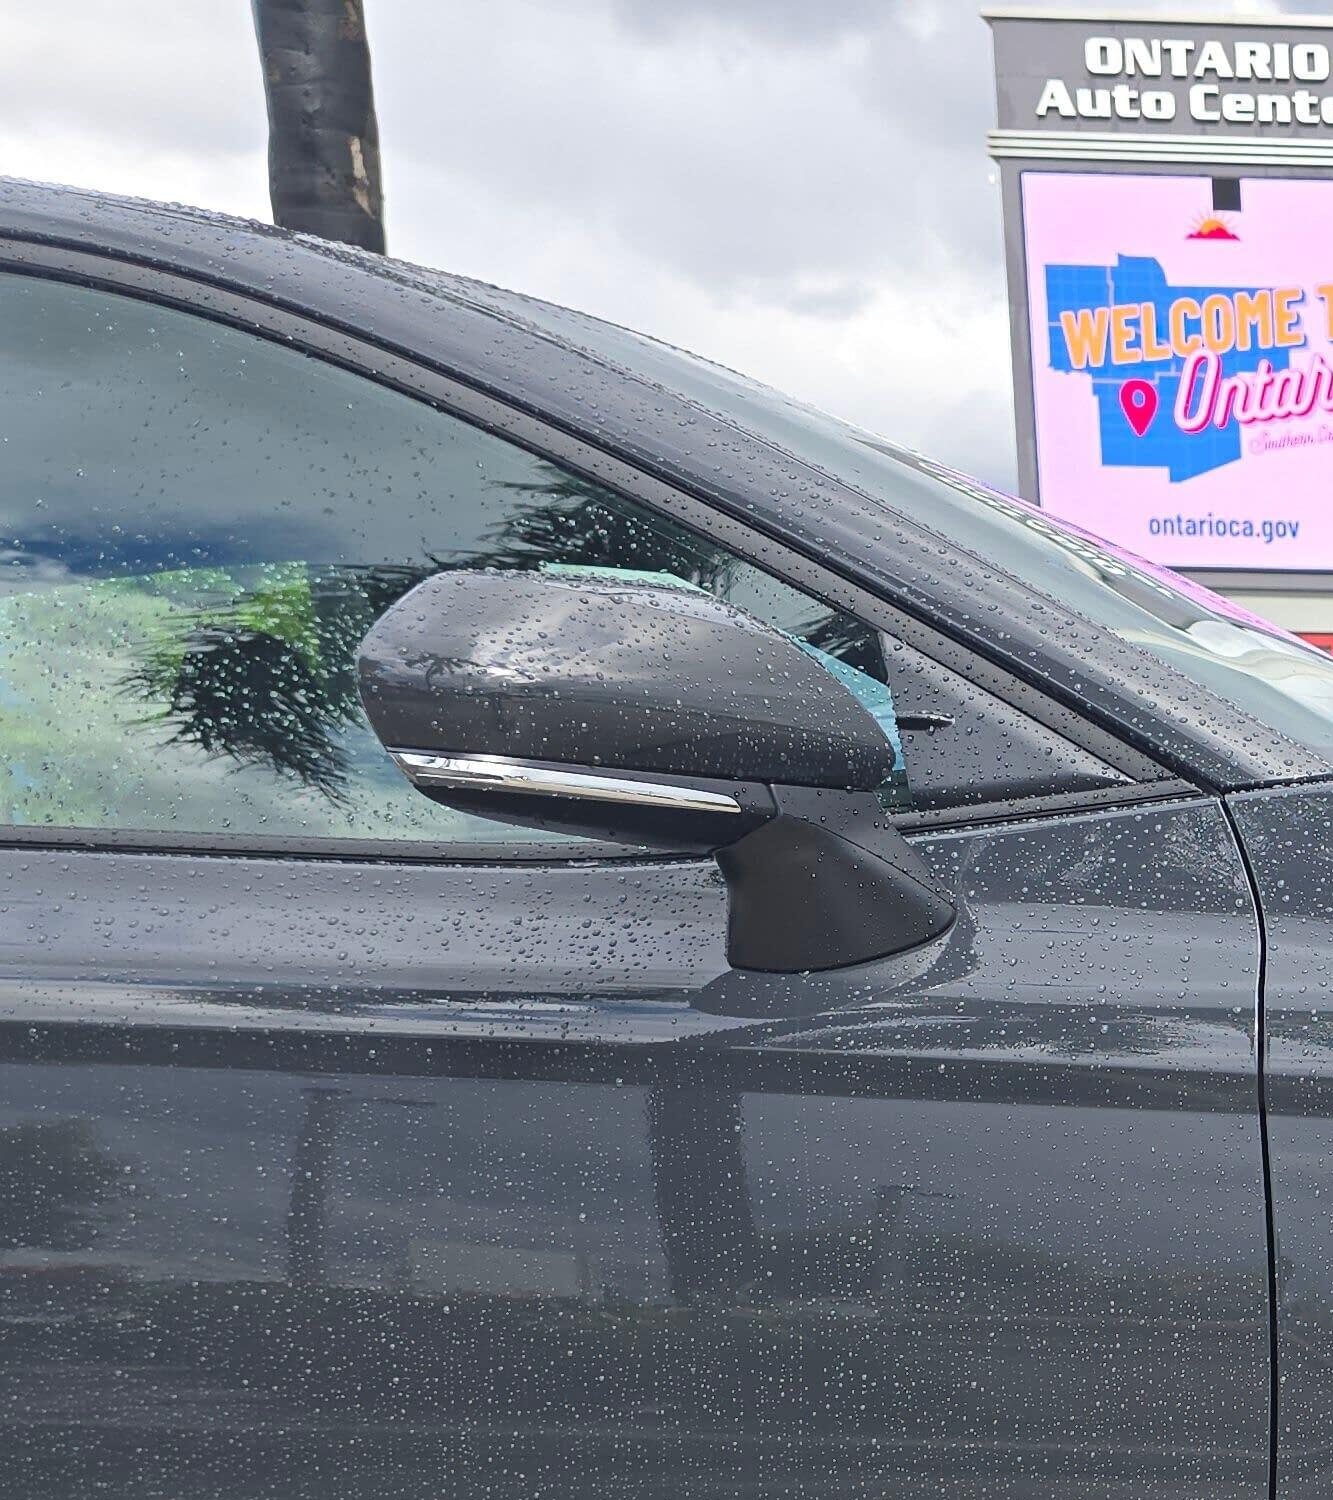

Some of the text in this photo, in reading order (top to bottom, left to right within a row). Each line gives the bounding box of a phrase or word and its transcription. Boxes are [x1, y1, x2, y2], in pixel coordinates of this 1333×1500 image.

[1083, 35, 1330, 82] ONTARIO
[1034, 78, 1177, 121] Auto
[1060, 286, 1308, 370] WELCOME
[1149, 512, 1300, 545] ontarioca.gov
